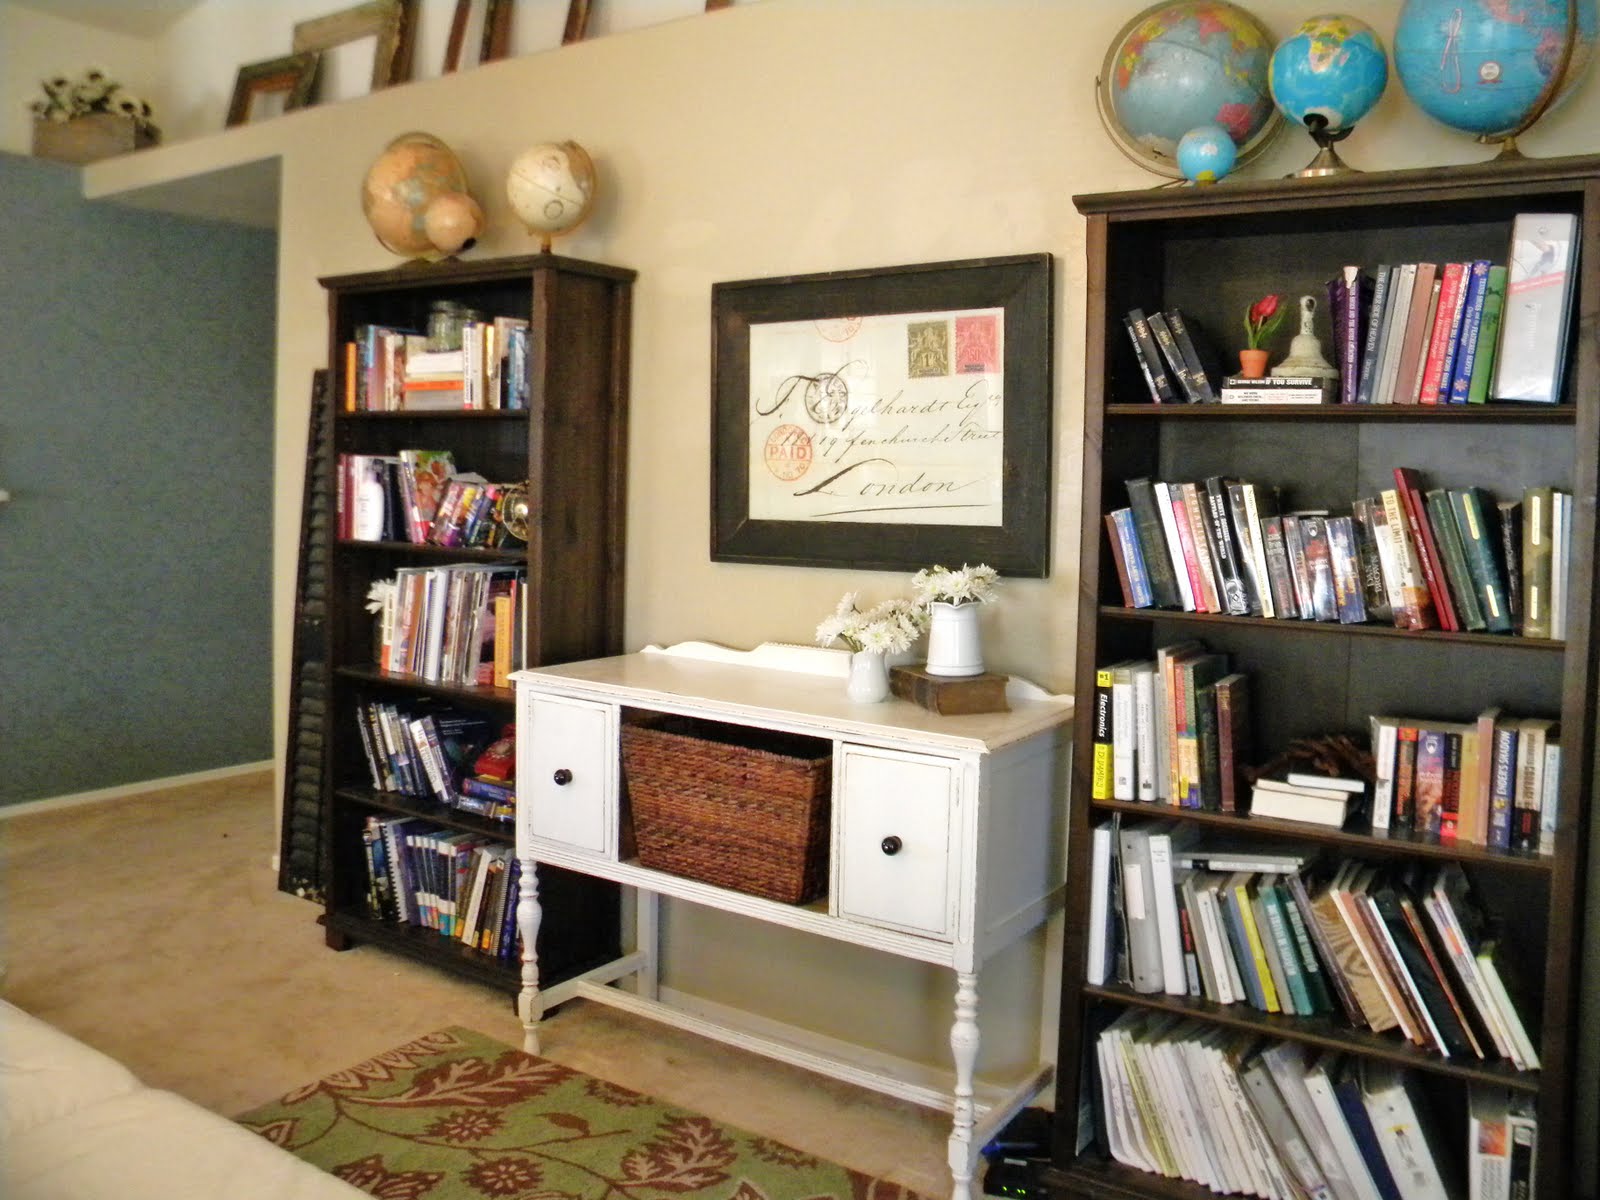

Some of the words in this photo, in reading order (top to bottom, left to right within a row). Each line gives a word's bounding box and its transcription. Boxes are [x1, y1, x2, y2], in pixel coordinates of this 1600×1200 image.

[1375, 284, 1383, 304] OTHER
[1478, 278, 1486, 295] TENNIS
[1475, 296, 1484, 311] SHOES
[1372, 319, 1378, 327] OF
[1368, 328, 1376, 351] HEAVEN
[770, 446, 807, 459] PAID
[794, 458, 988, 496] London
[1216, 495, 1225, 516] TWENTY
[1385, 495, 1395, 505] TO
[1388, 507, 1398, 521] THE
[1214, 520, 1220, 528] OF
[1218, 541, 1227, 559] WORLD
[1391, 523, 1402, 546] LIMIT
[1364, 565, 1374, 587] DAN
[1371, 555, 1382, 592] BROWN
[1099, 693, 1107, 737] Electronics
[1499, 731, 1510, 764] SHADOW
[1497, 764, 1508, 795] ENDER'S
